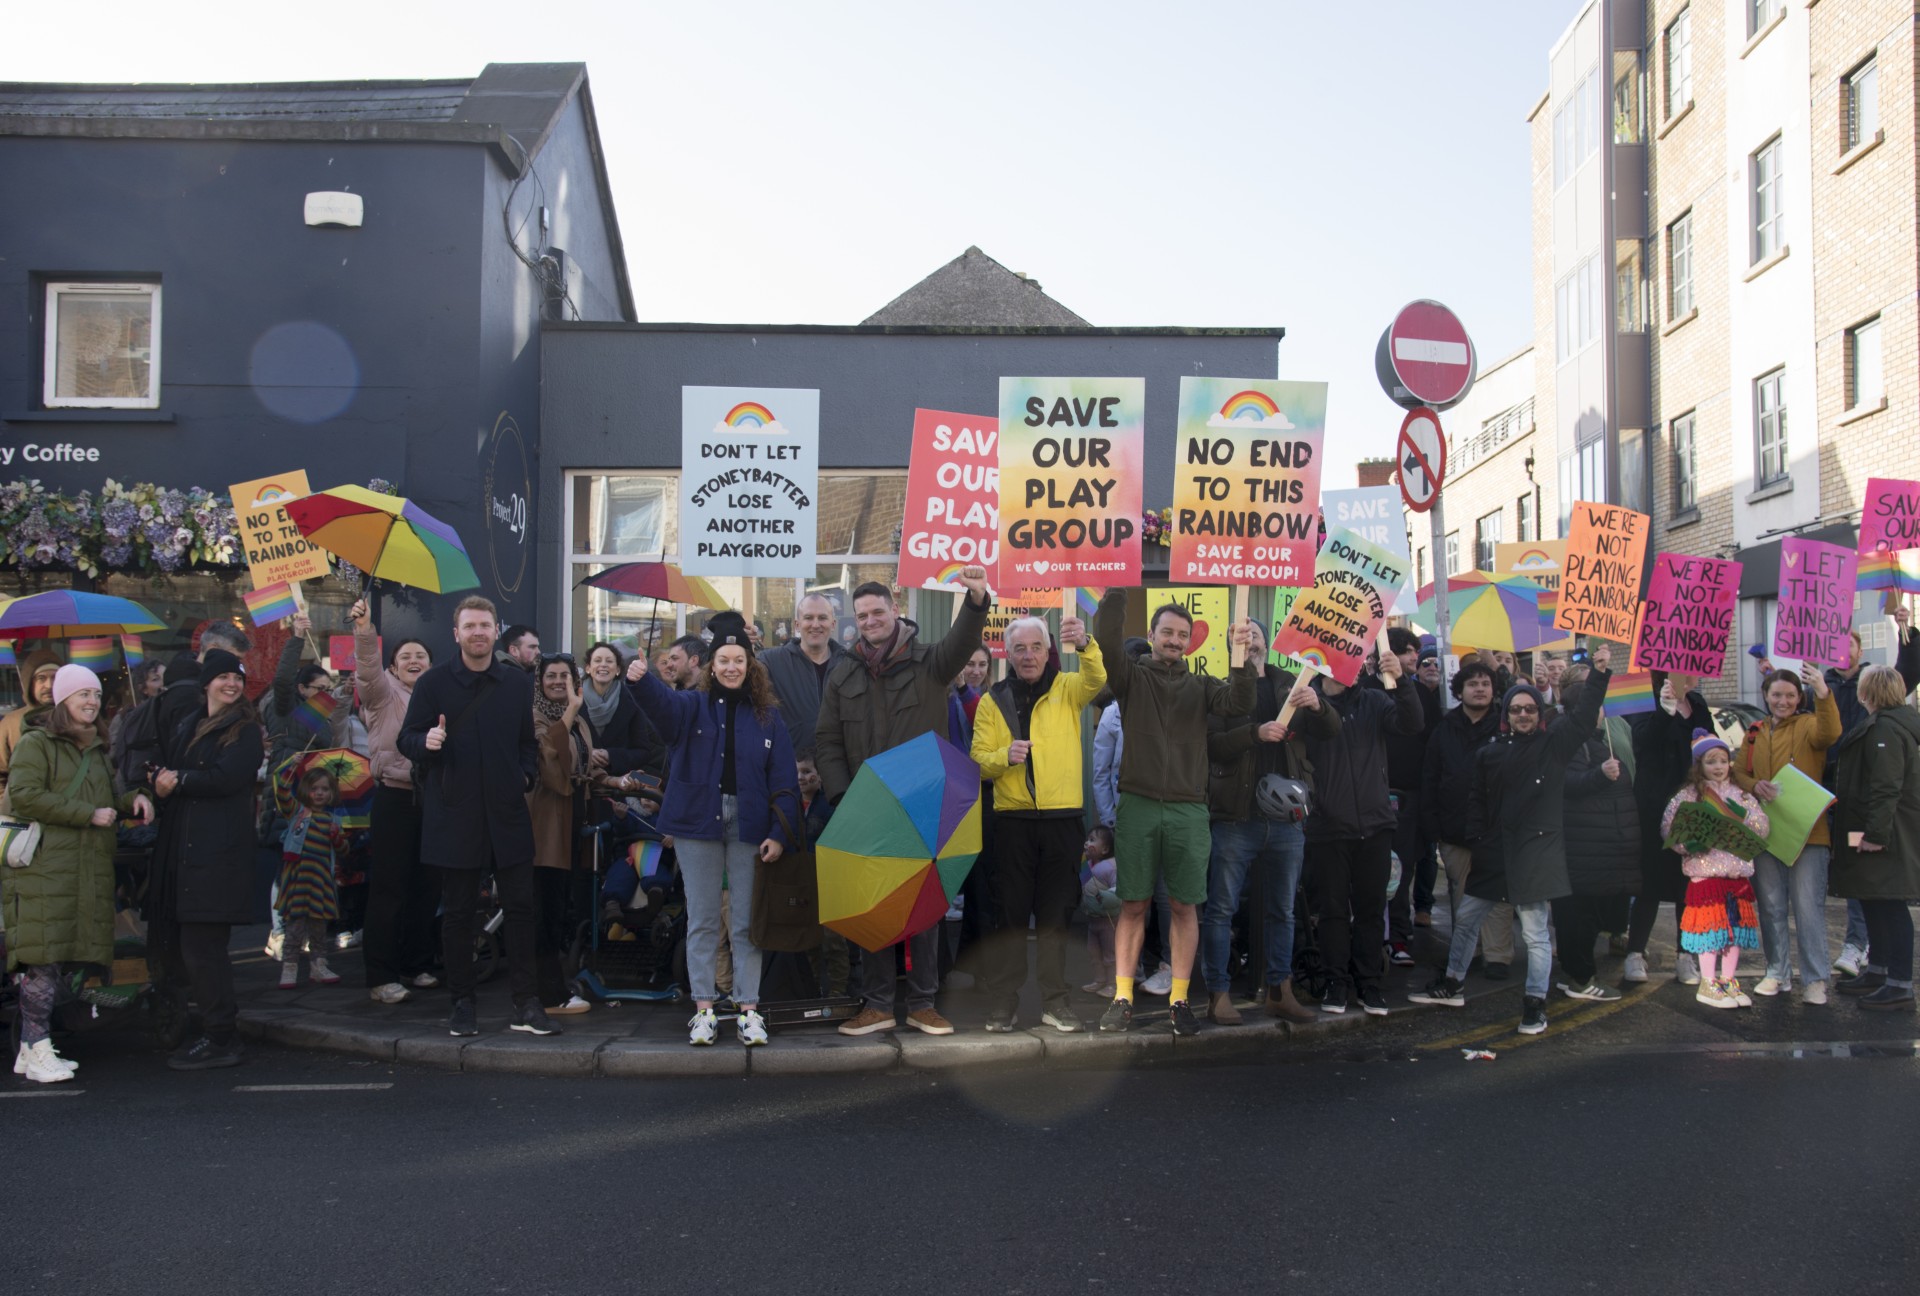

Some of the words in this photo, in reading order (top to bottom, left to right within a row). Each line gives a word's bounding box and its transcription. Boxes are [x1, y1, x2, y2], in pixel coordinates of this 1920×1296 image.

[1024, 396, 1121, 428] SAVE
[22, 443, 100, 462] Coffee
[701, 443, 758, 459] DON'T
[767, 445, 801, 460] LET
[932, 424, 999, 458] SAV
[1032, 437, 1112, 468] OUR
[1187, 437, 1235, 466] NO
[1250, 439, 1313, 469] END
[691, 468, 810, 510] STONEYBATTER
[728, 493, 773, 509] LOSE
[1025, 477, 1117, 508] PLAY
[1192, 476, 1231, 502] TO
[1243, 478, 1304, 505] THIS
[926, 496, 999, 530] PLAY
[1337, 498, 1390, 521] SAVE
[1874, 493, 1920, 516] SAV
[245, 512, 270, 530] NO
[492, 496, 511, 524] Project
[510, 493, 526, 545] 29
[706, 518, 795, 534] ANOTHER
[1178, 508, 1314, 541] RAINBOW
[1588, 508, 1637, 535] WE'RE
[253, 530, 273, 545] TO
[278, 524, 302, 540] TH
[1007, 518, 1134, 549] GROUP
[1596, 533, 1631, 558] NOT
[698, 542, 802, 558] PLAYGROUP
[907, 531, 999, 566] GROU
[1196, 543, 1244, 561] SAVE
[1253, 546, 1292, 562] OUR
[1329, 540, 1372, 569] DON'T
[1373, 562, 1401, 584] LET
[266, 566, 317, 583] PLAYGROUP!
[268, 564, 290, 574] SAVE
[294, 559, 311, 569] OUR
[1015, 563, 1032, 573] WE
[1051, 563, 1072, 572] OUR
[1075, 562, 1126, 572] TEACHERS
[1186, 562, 1299, 581] PLAYGROUP!
[1565, 554, 1636, 588] PLAYING
[1667, 558, 1728, 585] WE'RE
[1803, 550, 1846, 579] LET
[1533, 574, 1560, 588] THI
[1675, 583, 1721, 604] NOT
[1788, 578, 1838, 608] THIS
[1328, 587, 1363, 613] LOSE
[1304, 600, 1368, 639] ANOTHER
[1559, 608, 1632, 640] STAYING!
[1776, 601, 1853, 636] RAINBOW
[1288, 614, 1364, 659] PLAYGROUP
[1777, 629, 1839, 663] SHINE
[1638, 648, 1724, 676] STAYING!
